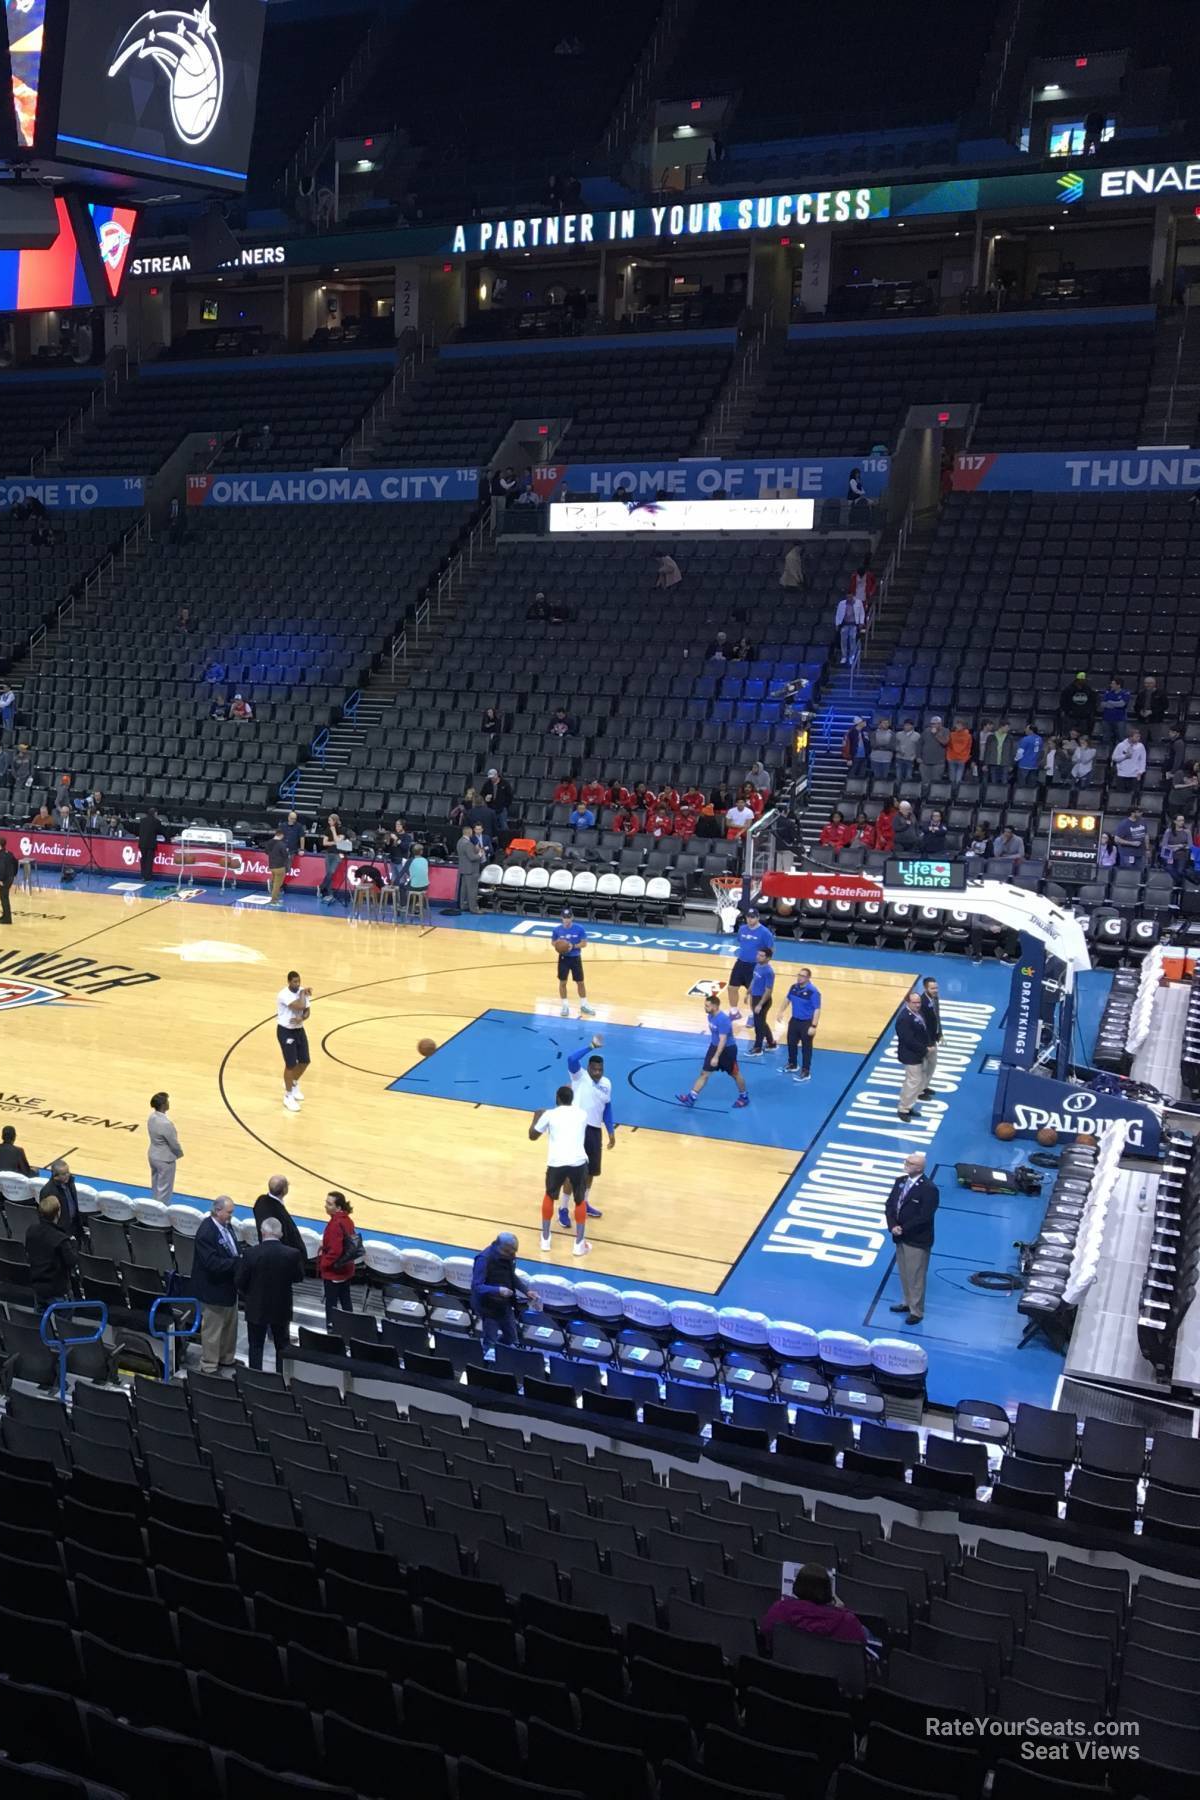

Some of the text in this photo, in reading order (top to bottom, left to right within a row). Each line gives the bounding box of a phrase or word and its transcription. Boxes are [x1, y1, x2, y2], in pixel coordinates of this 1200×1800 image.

[452, 188, 872, 253] A PARTNER IN YOUR SUCCESS
[862, 459, 888, 472] 116
[958, 457, 984, 471] 117
[457, 469, 478, 482] 115
[535, 467, 557, 480] 116
[589, 466, 823, 495] HOME OF THE
[123, 479, 142, 490] 114
[189, 477, 207, 489] 115
[212, 475, 450, 503] OKLAHOMA CITY
[65, 484, 99, 505] TO
[32, 842, 82, 858] Medicine
[1064, 850, 1097, 860] TISSOT
[898, 861, 930, 875] Life
[903, 873, 951, 887] Share
[729, 887, 743, 901] G
[836, 899, 850, 911] G
[865, 901, 880, 914] G
[894, 903, 909, 916] G
[6, 910, 68, 922] RENA
[922, 906, 938, 919] G
[952, 909, 968, 921] G
[1028, 914, 1059, 941] SPALDING
[1104, 918, 1121, 935] G
[1136, 921, 1153, 938] G
[1015, 981, 1032, 1055] DRAFTKINGS
[29, 1108, 140, 1133] ARENA
[1012, 1104, 1145, 1147] SPALDIG
[761, 1142, 928, 1269] THUNDER
